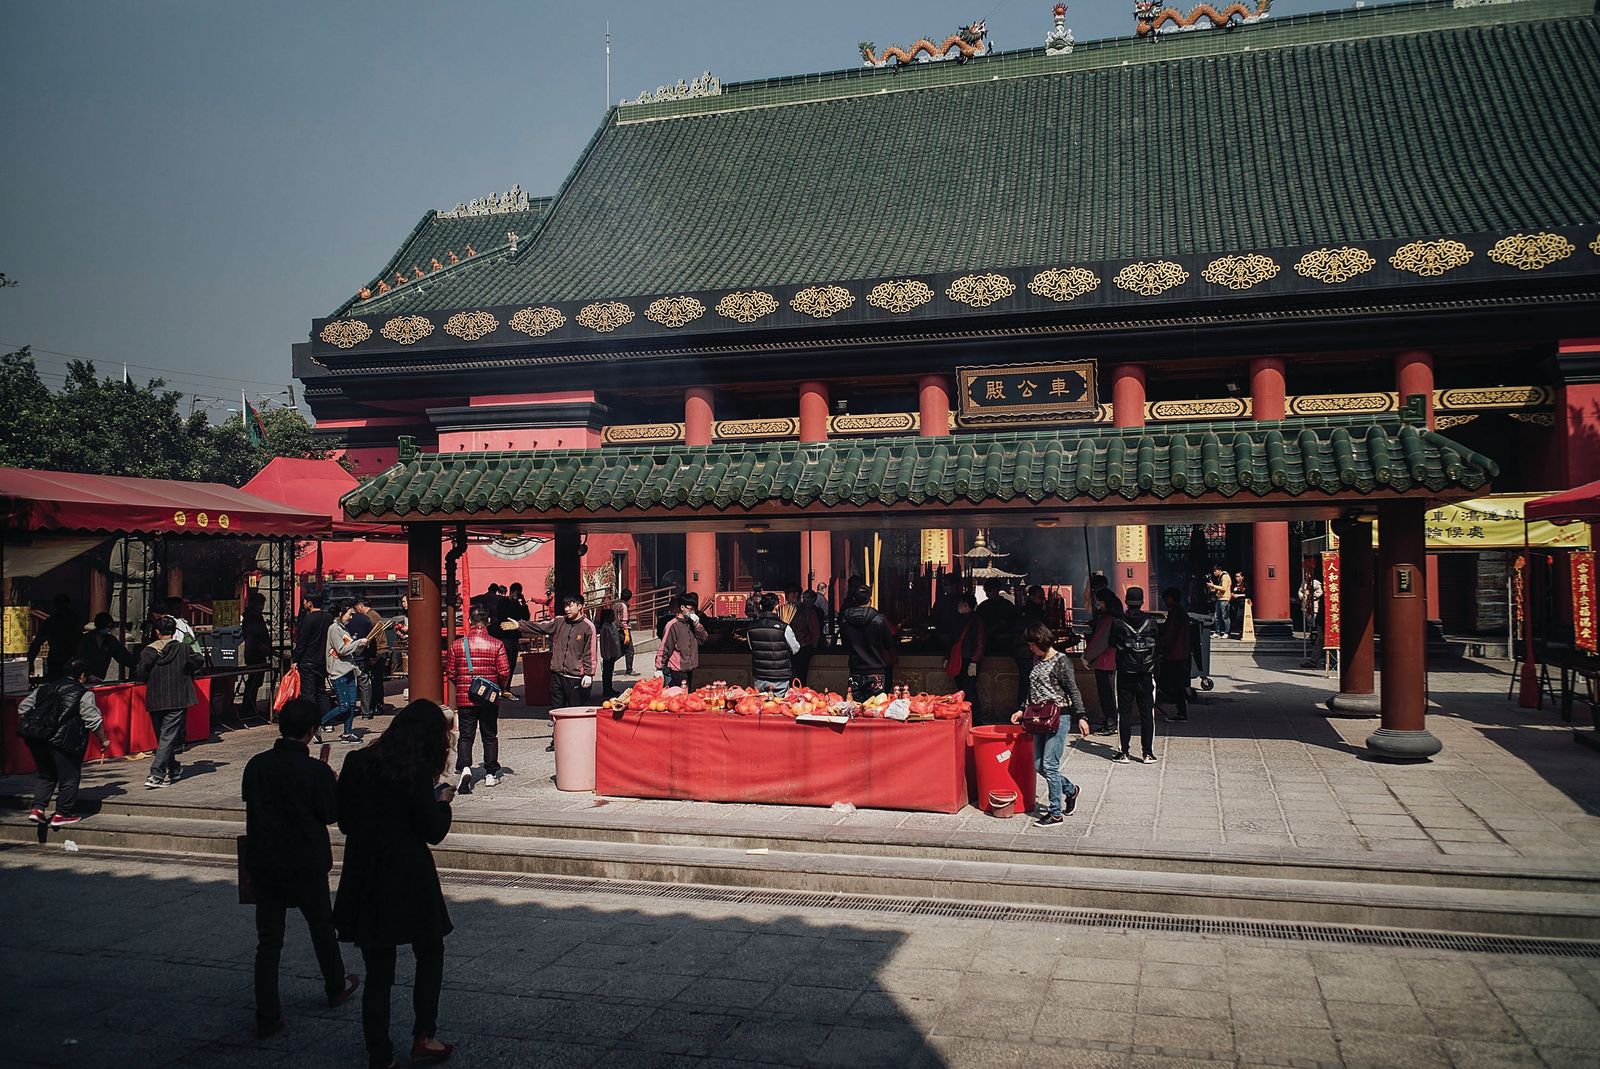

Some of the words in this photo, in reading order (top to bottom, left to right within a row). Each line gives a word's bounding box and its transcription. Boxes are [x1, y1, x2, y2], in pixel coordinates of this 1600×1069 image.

[986, 377, 1070, 400] 車公殿
[1425, 509, 1524, 522] 車/鴻運鼓
